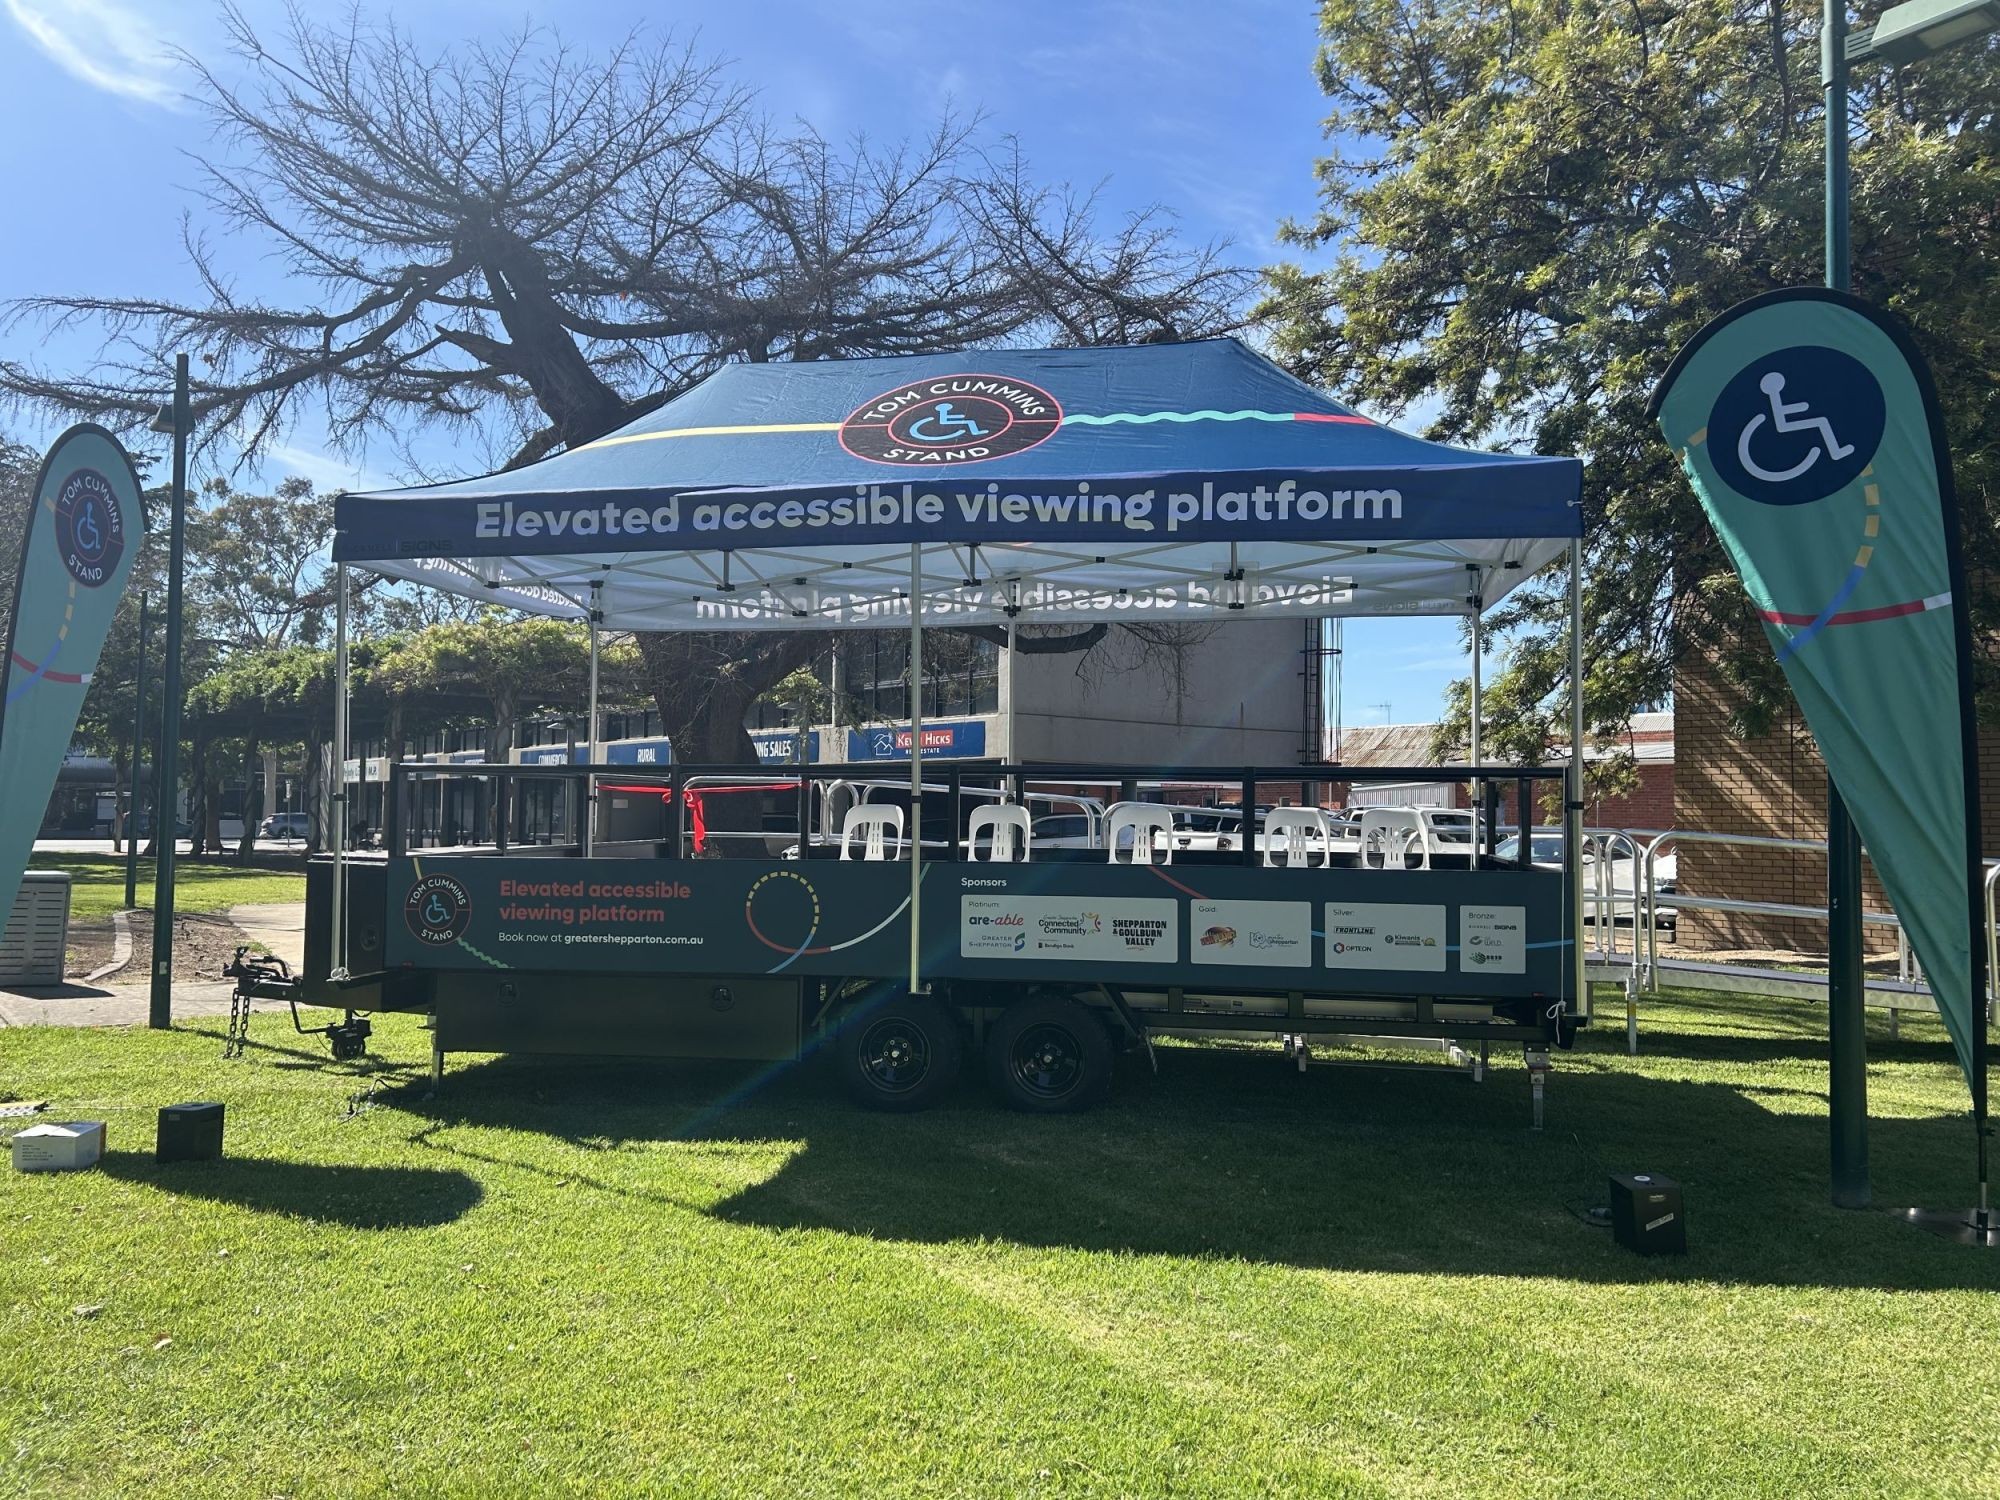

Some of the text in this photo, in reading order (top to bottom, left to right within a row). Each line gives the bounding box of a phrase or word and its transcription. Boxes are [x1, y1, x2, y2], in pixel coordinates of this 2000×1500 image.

[863, 380, 1045, 421] TOM CUMMINS
[883, 447, 990, 461] STAND
[62, 476, 119, 533] TOM CUMMINS
[475, 479, 1403, 538] Elevated accessible viewing platform
[69, 554, 102, 580] STAND
[925, 732, 951, 745] HICKS
[637, 748, 656, 763] RURAL
[770, 740, 791, 757] SALES
[500, 880, 692, 898] Elevated accessible
[961, 878, 1008, 888] Sponsors
[409, 879, 466, 905] TOM CUMMINS
[499, 903, 665, 924] viewing platform
[969, 913, 1024, 926] are-able
[1038, 919, 1080, 928] Connected
[1112, 919, 1168, 929] SHEPPARTON
[421, 929, 453, 941] STAND
[1044, 926, 1087, 936] Community
[1335, 927, 1375, 935] FRONTLINE
[498, 932, 704, 946] Book now at greatershepparton.com.au
[1125, 937, 1156, 947] VALLEY
